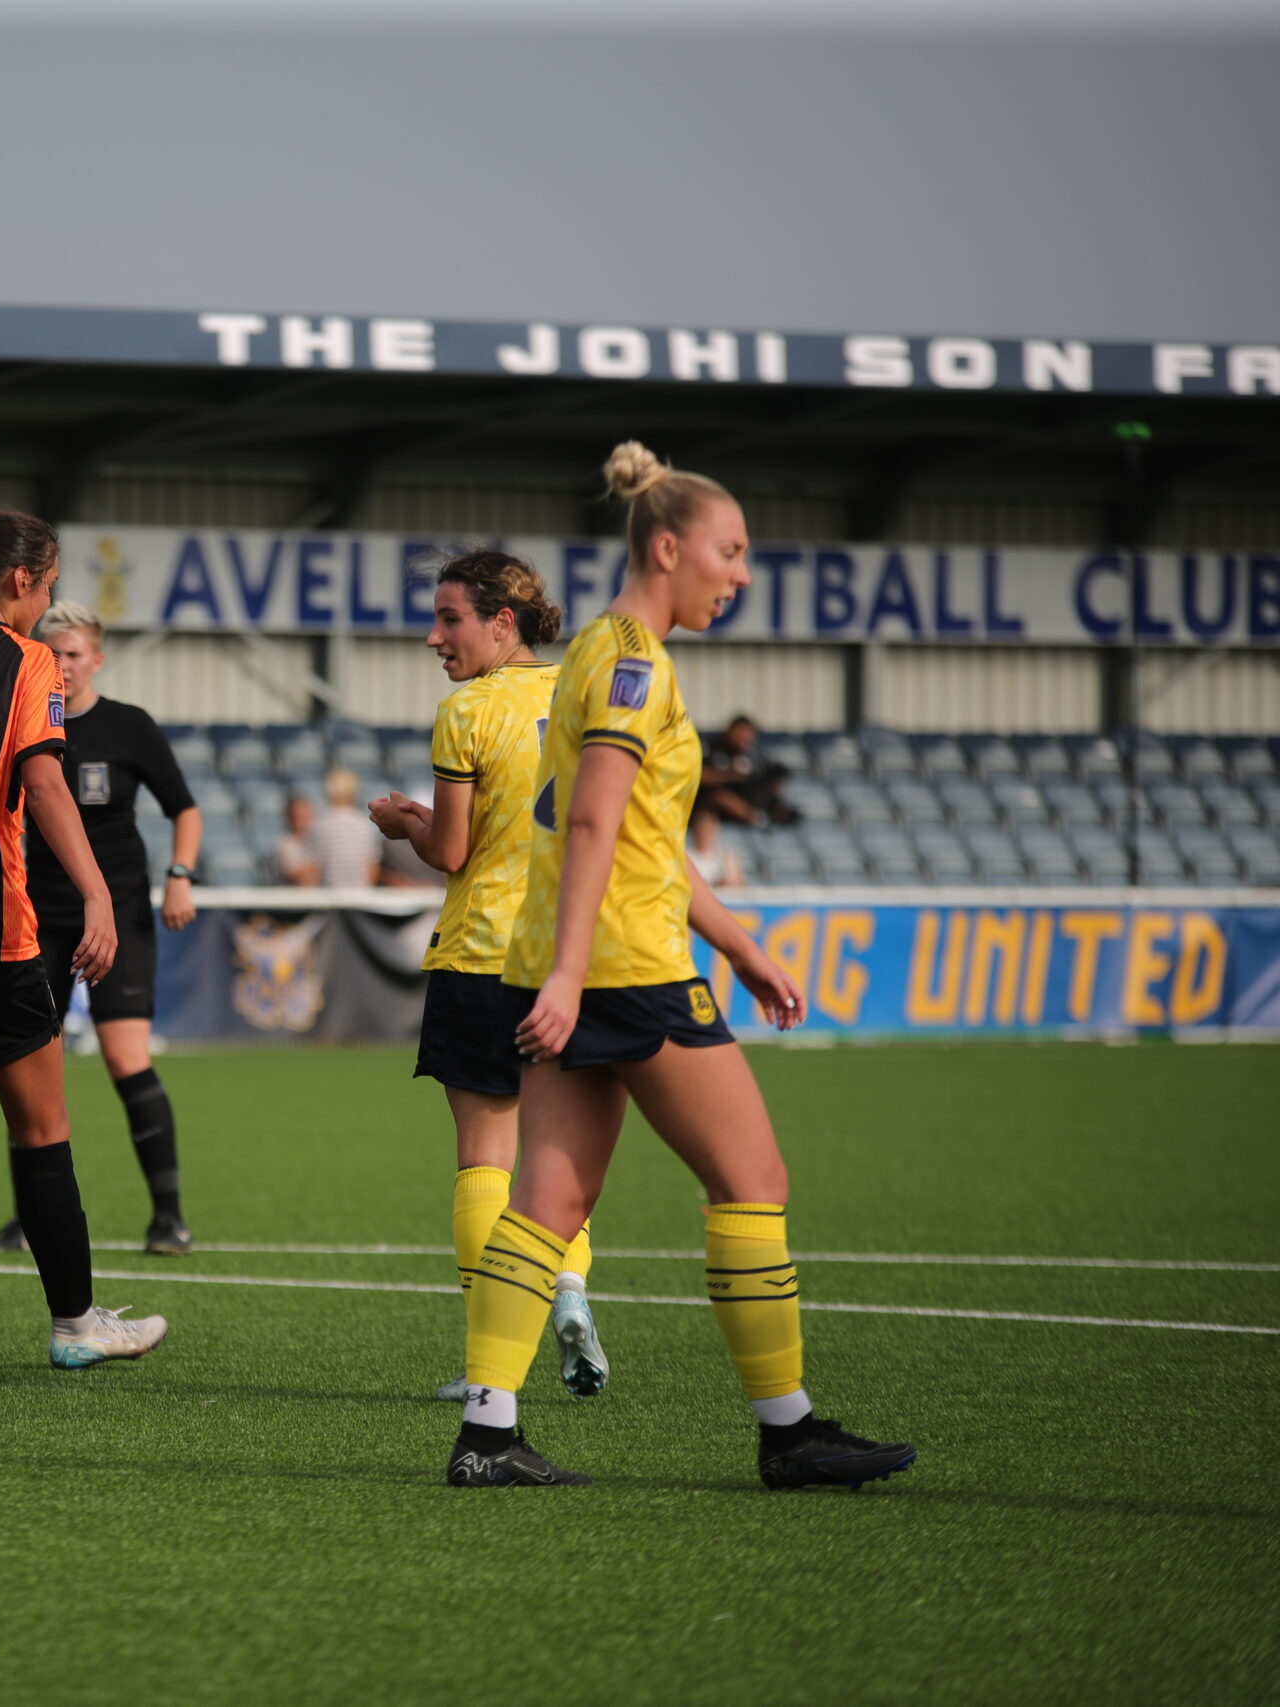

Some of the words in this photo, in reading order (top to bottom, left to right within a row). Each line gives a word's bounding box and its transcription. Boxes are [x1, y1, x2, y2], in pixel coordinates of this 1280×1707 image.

[199, 312, 437, 373] THE
[160, 532, 515, 629] AVELE
[561, 541, 1028, 641] FTBALL
[1071, 548, 1280, 645] CLUB
[905, 909, 1228, 1027] UNITED
